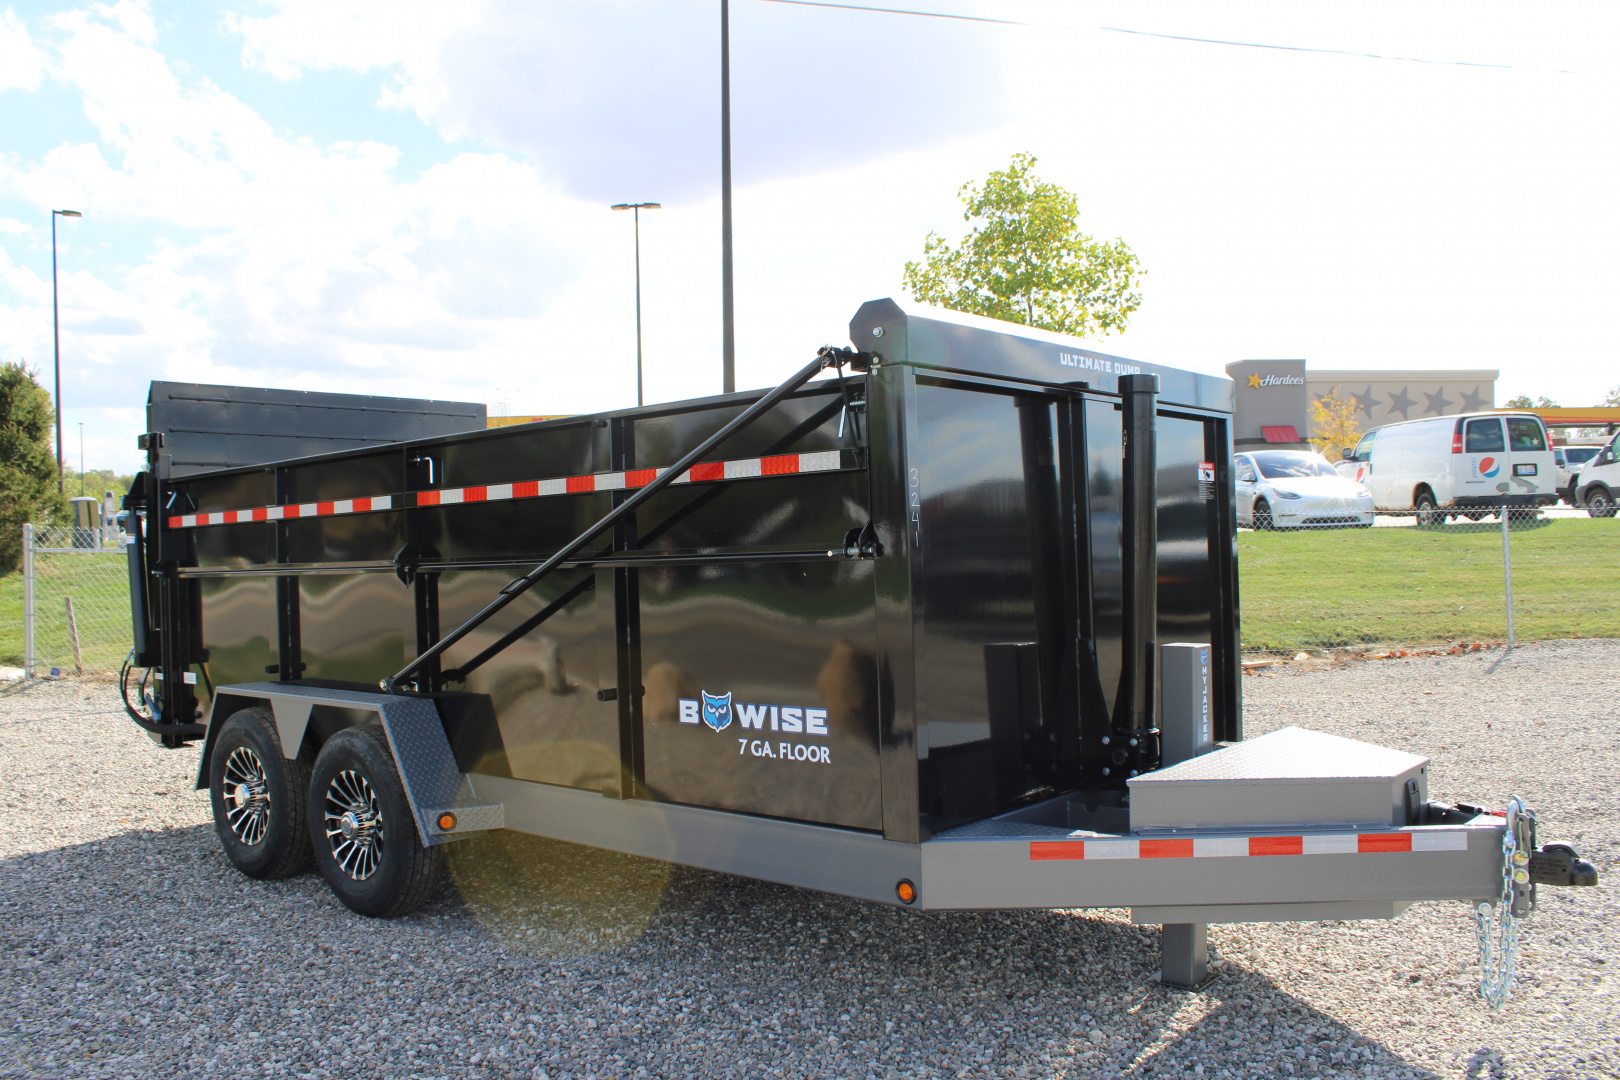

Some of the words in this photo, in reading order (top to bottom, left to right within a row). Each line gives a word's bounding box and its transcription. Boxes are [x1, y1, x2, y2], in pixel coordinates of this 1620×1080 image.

[1060, 352, 1112, 373] ULTIMATE
[1260, 374, 1304, 387] Hardee's
[910, 468, 920, 547] 3241
[738, 738, 748, 755] 7
[751, 740, 777, 759] GA.
[779, 742, 831, 764] FLOOR
